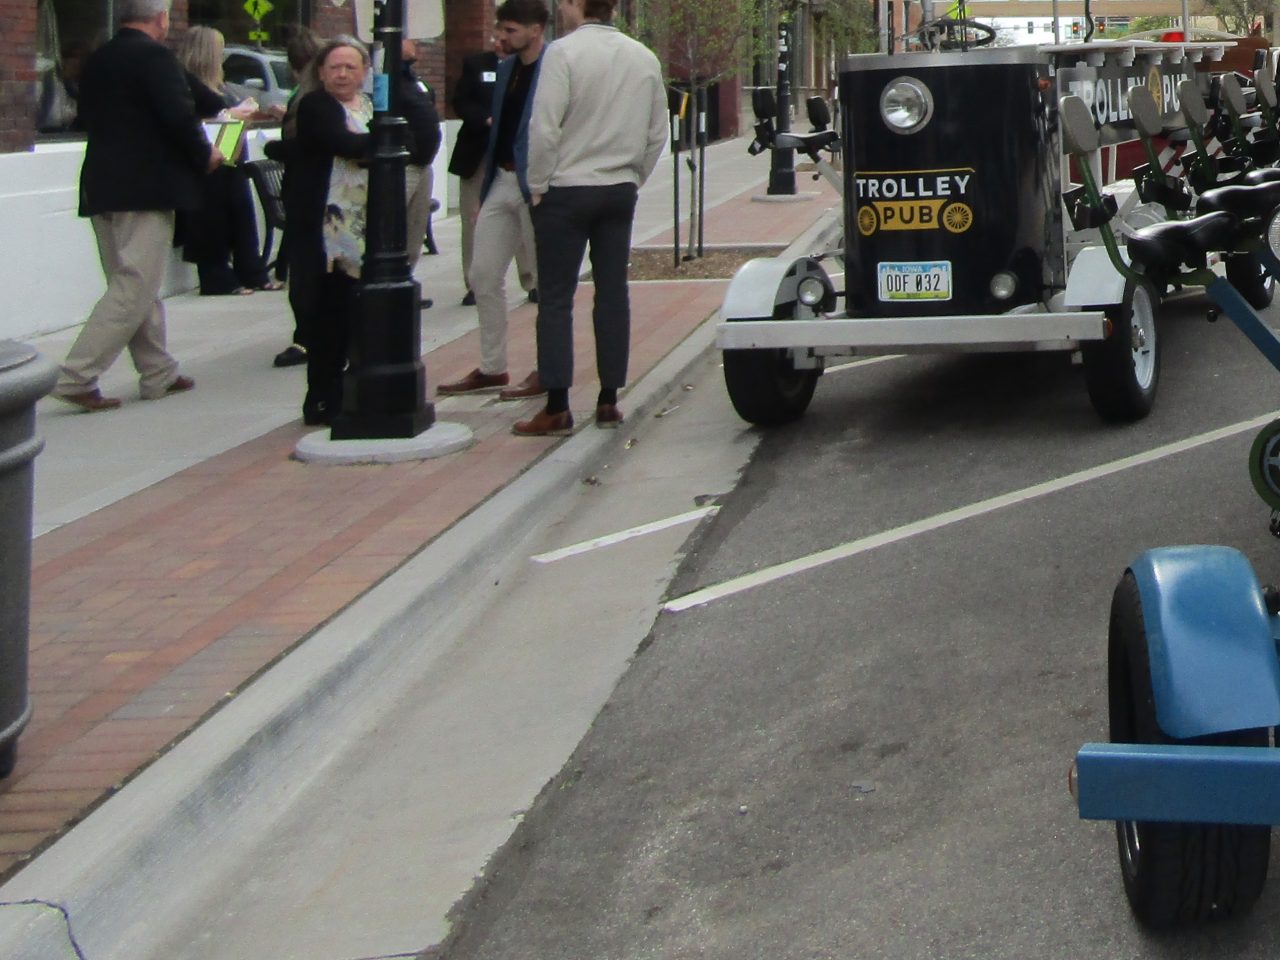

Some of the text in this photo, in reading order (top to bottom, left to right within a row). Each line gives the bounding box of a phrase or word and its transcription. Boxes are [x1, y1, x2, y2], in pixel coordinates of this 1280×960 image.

[1069, 73, 1188, 125] TROLL PU
[855, 174, 970, 198] TROLLEY
[883, 205, 933, 225] PUB
[902, 265, 923, 273] IOWA
[916, 273, 941, 292] 032
